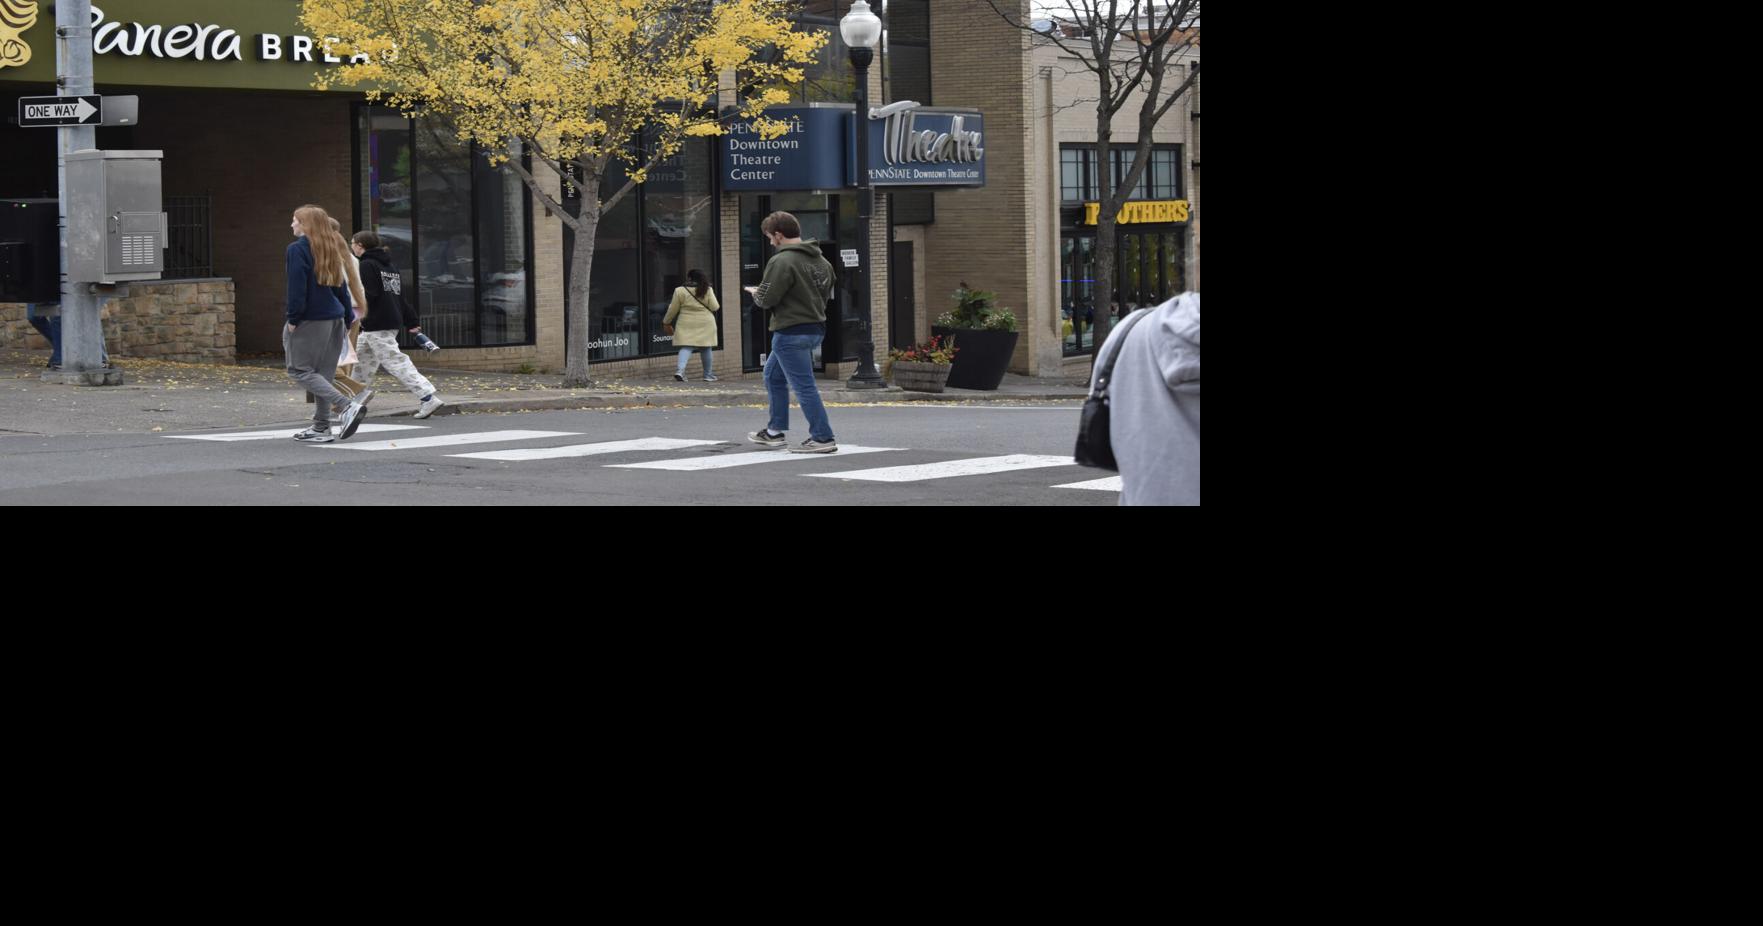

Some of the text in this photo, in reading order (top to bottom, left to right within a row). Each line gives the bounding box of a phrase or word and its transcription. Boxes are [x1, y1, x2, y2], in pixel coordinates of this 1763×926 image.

[28, 105, 77, 118] ONE WAY
[729, 120, 805, 134] PENTE
[868, 100, 984, 166] Theatre
[730, 138, 799, 150] Downtown
[730, 153, 781, 165] Theatre
[730, 168, 775, 180] Center
[868, 167, 911, 179] ENNSTATE
[913, 168, 947, 178] Downtown
[947, 168, 966, 178] Theatre
[1084, 200, 1189, 225] OTHERS
[587, 336, 629, 349] oohun Joo
[653, 334, 673, 343] Souna
